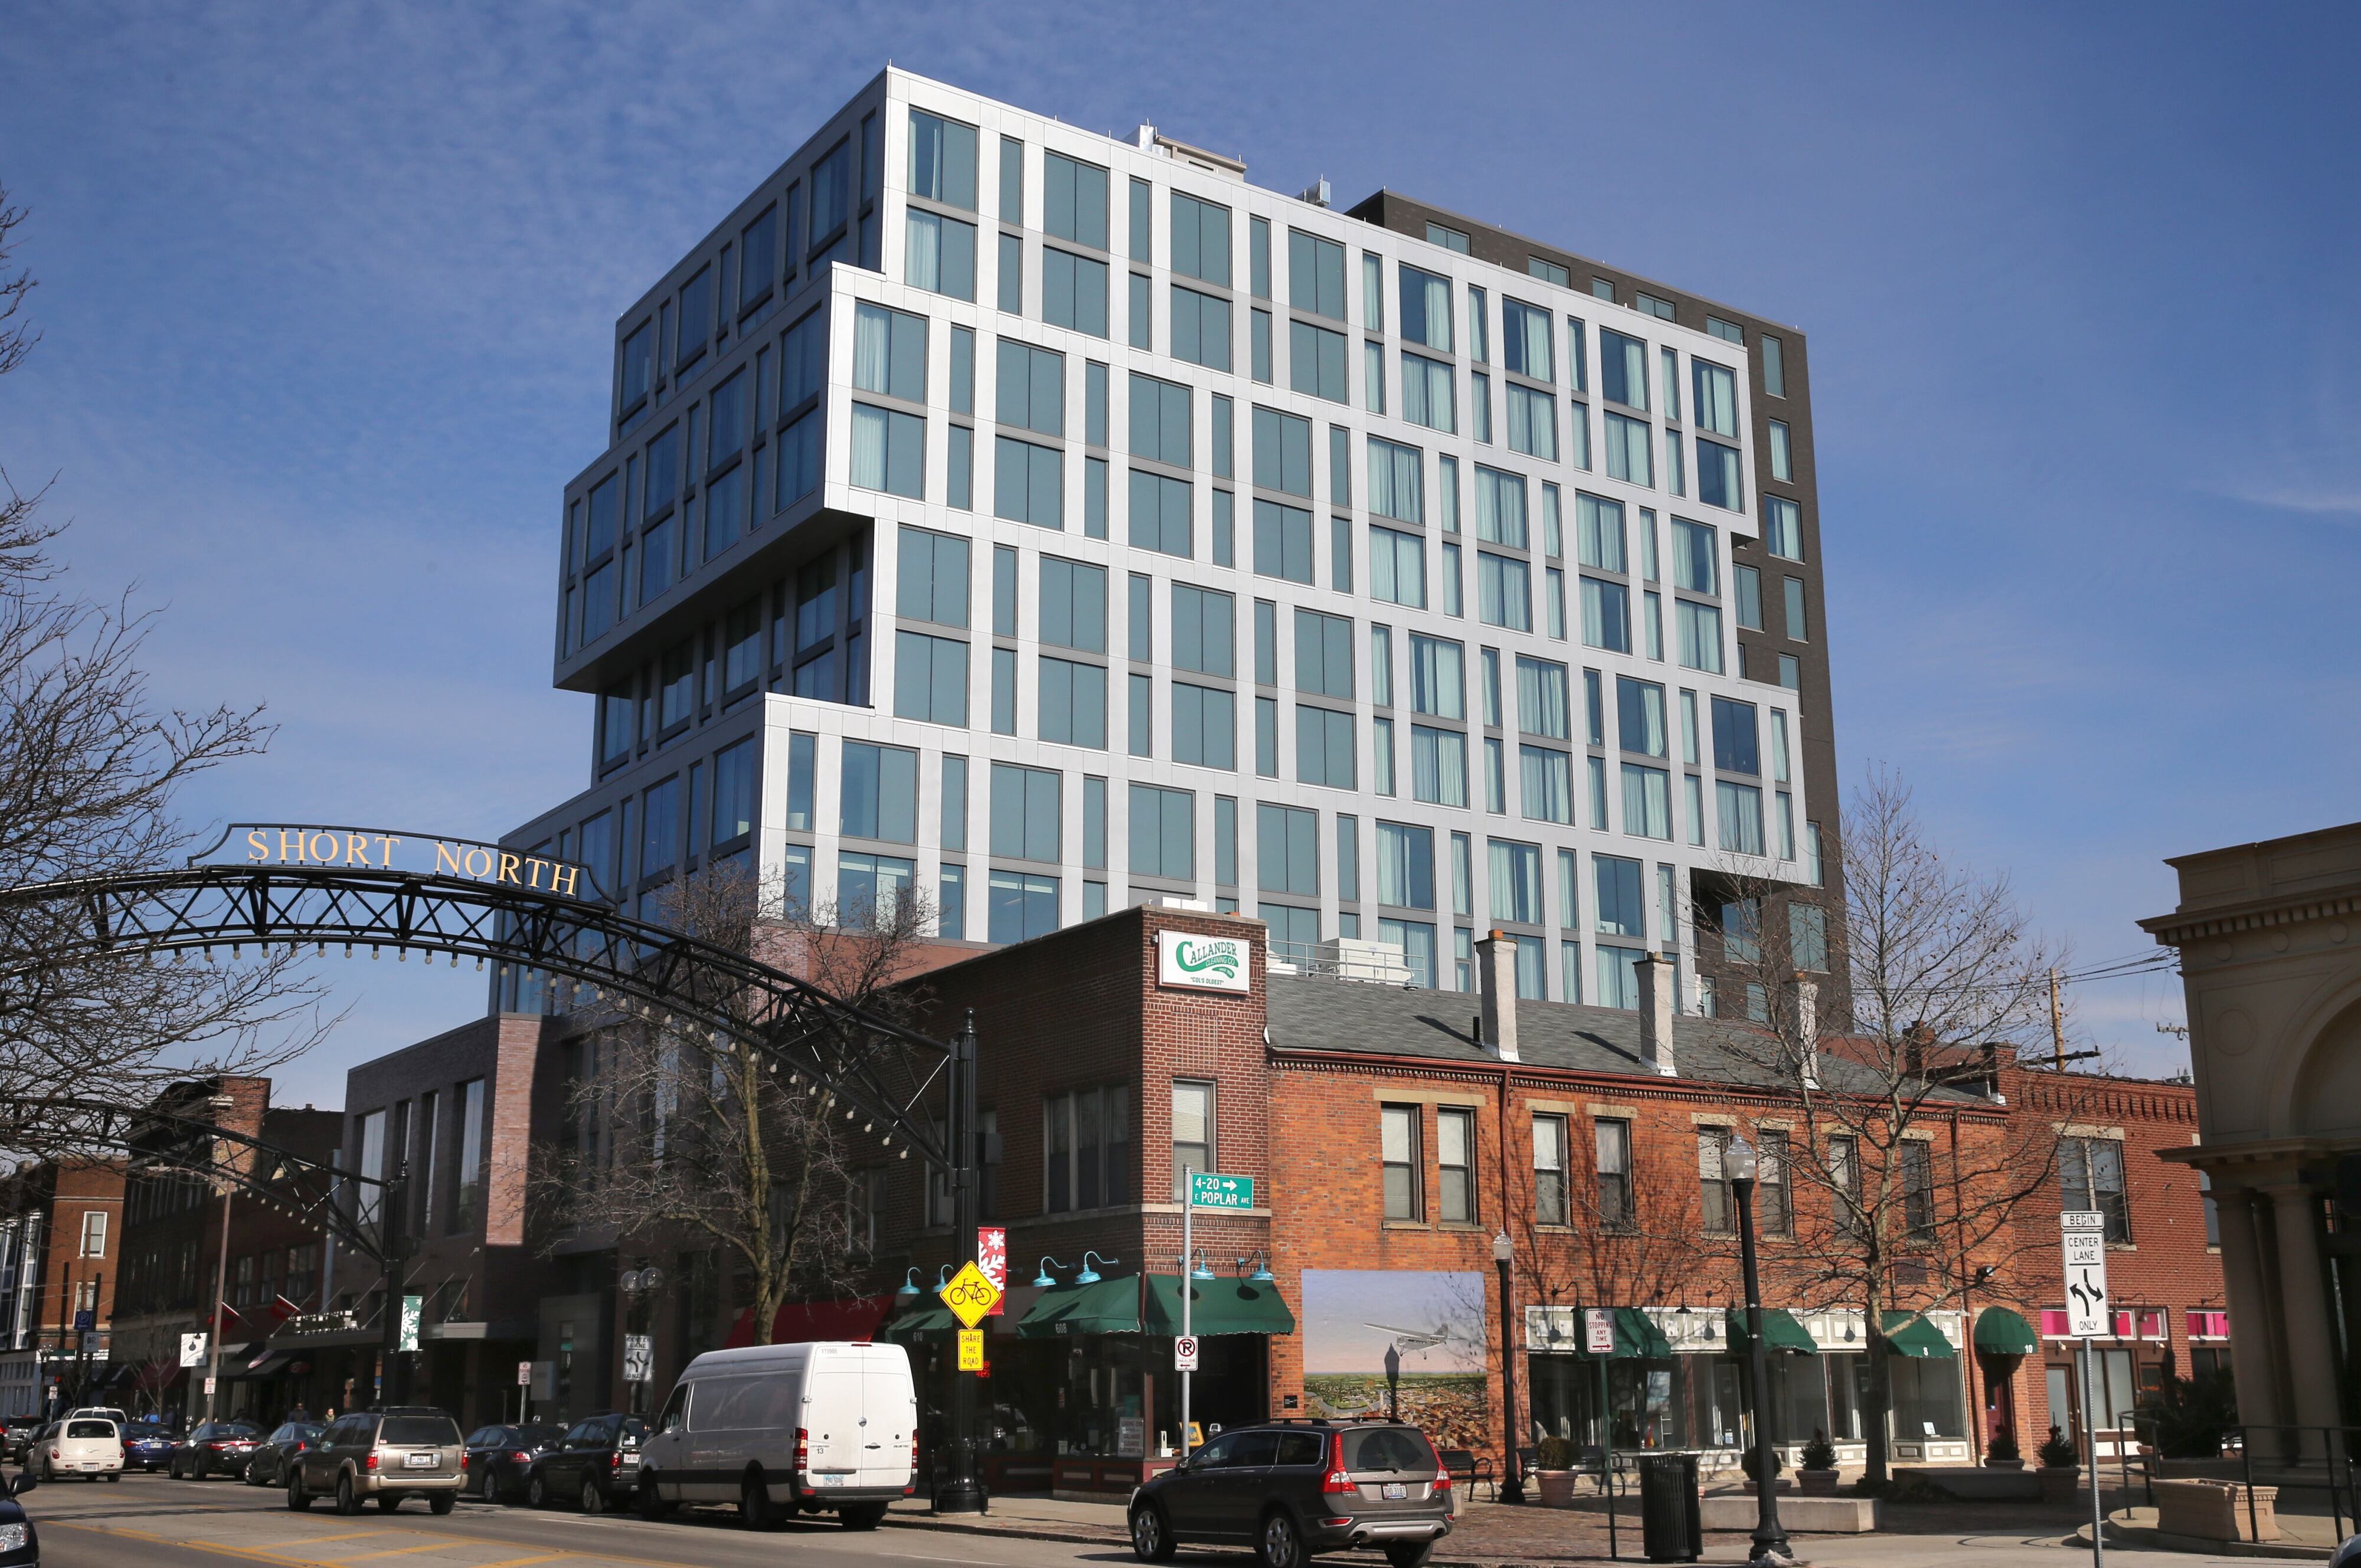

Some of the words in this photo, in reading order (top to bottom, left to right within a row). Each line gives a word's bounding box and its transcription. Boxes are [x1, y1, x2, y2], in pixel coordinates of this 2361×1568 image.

[247, 831, 400, 867] SHORT
[433, 843, 580, 896] NORTH
[1176, 941, 1238, 971] CALLANDER
[1206, 956, 1227, 967] CLEANING
[1195, 1177, 1219, 1190] 4-20
[1201, 1191, 1237, 1206] POPLAR
[2069, 1215, 2096, 1225] BEGIN
[2068, 1238, 2099, 1247] CENTER
[2074, 1251, 2095, 1261] LANE
[1055, 1323, 1067, 1334] 608
[2079, 1321, 2098, 1330] ONLY
[913, 1332, 923, 1341] 610
[961, 1335, 980, 1343] SHARE
[1923, 1347, 1929, 1356] 8
[2025, 1344, 2033, 1354] 10
[963, 1357, 979, 1365] ROAD
